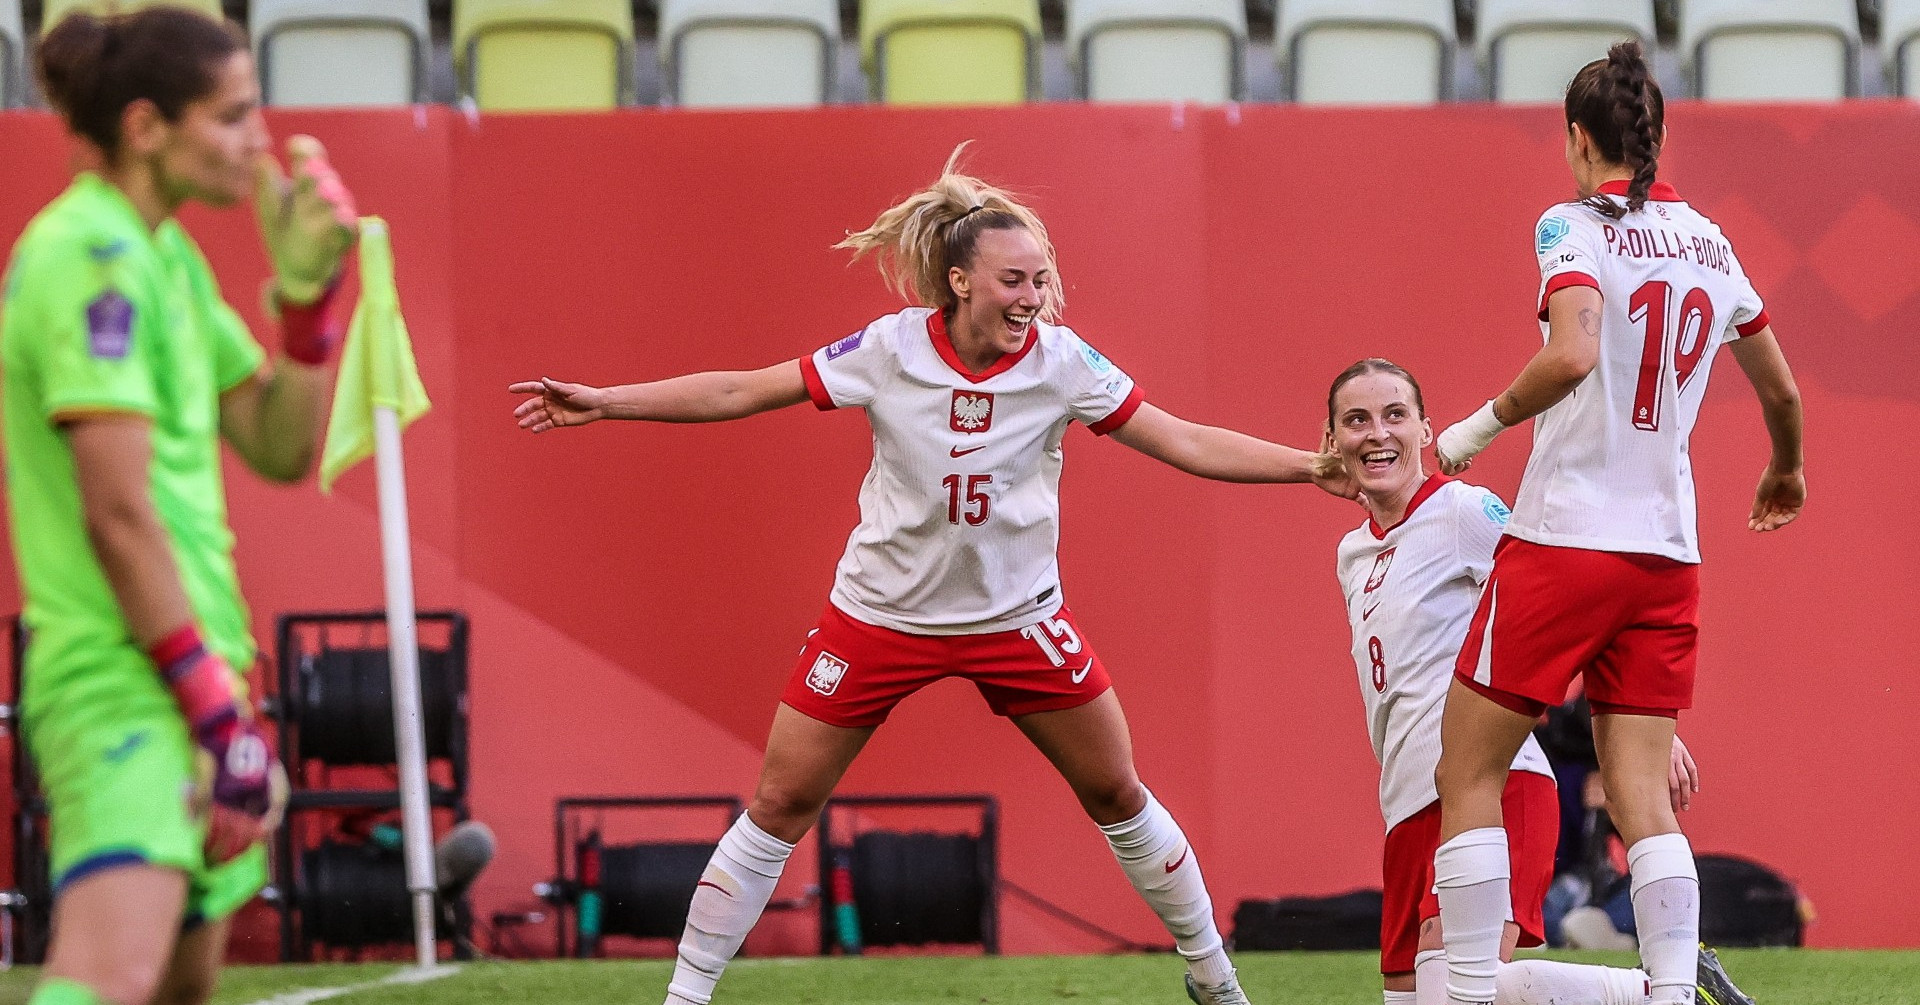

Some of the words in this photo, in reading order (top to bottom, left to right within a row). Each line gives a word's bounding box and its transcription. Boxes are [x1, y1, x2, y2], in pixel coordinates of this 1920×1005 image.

[1603, 224, 1730, 276] PADILLA-BIDAS
[1628, 280, 1715, 431] 19
[942, 473, 993, 527] 15
[1020, 617, 1082, 667] 15
[1368, 635, 1388, 695] 8
